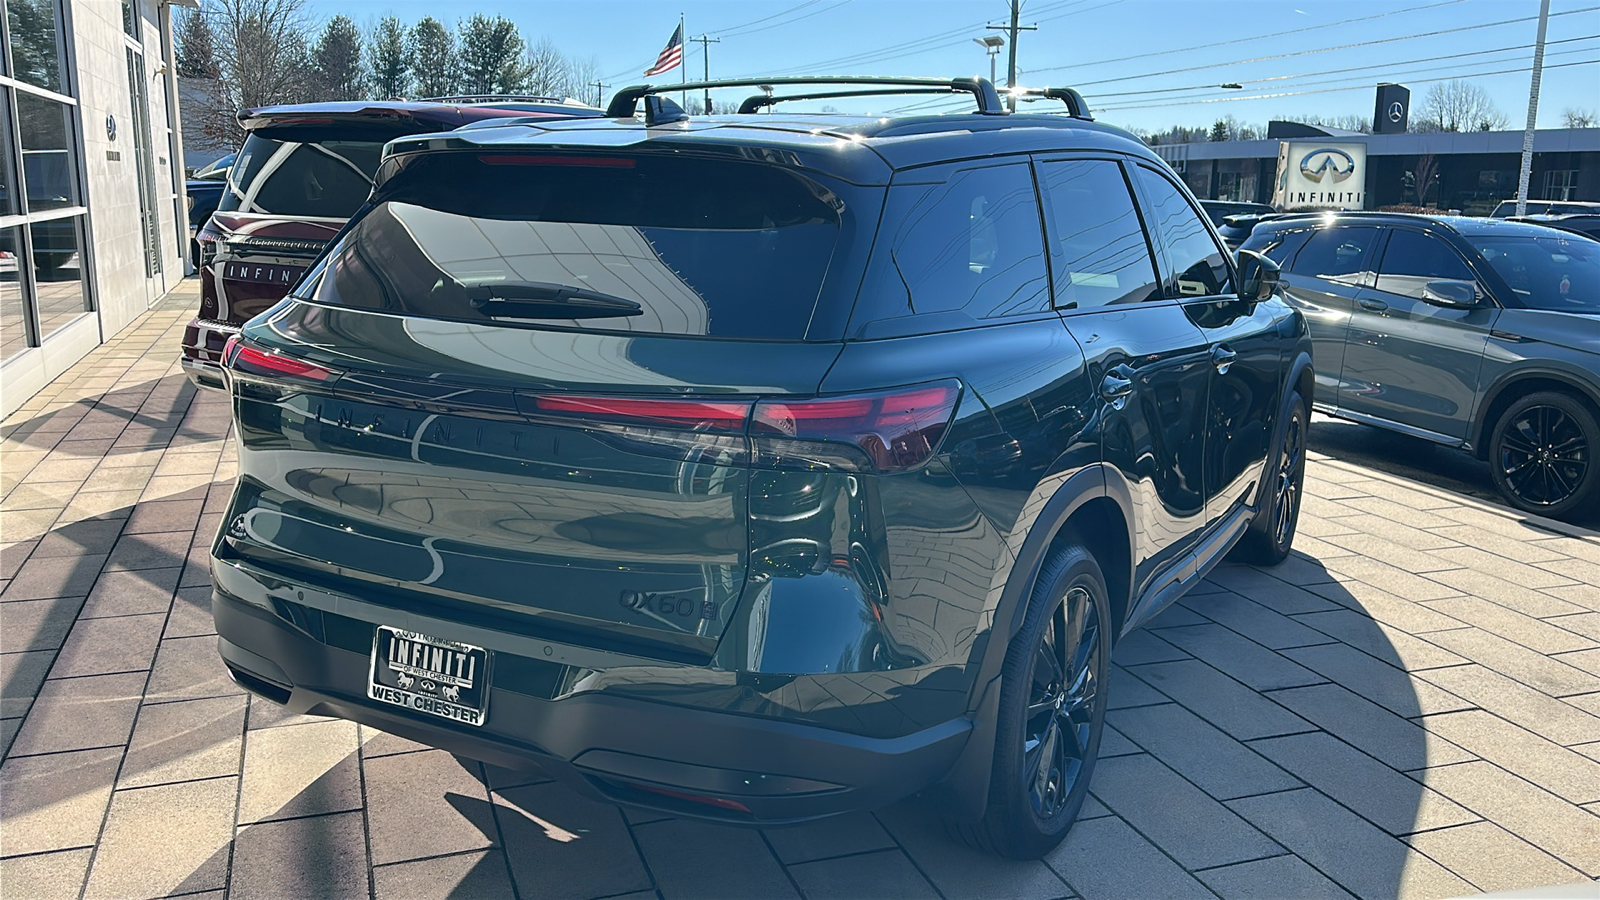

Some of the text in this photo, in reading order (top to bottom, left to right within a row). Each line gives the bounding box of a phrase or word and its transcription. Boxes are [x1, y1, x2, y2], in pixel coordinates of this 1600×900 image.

[1290, 192, 1361, 203] INFINITI
[314, 404, 560, 456] INFINITI
[618, 588, 695, 617] QX60
[388, 637, 476, 681] INFINITI
[403, 665, 457, 684] OF WEST CHESTER
[372, 685, 411, 706] WEST
[413, 696, 479, 724] CHESTER
